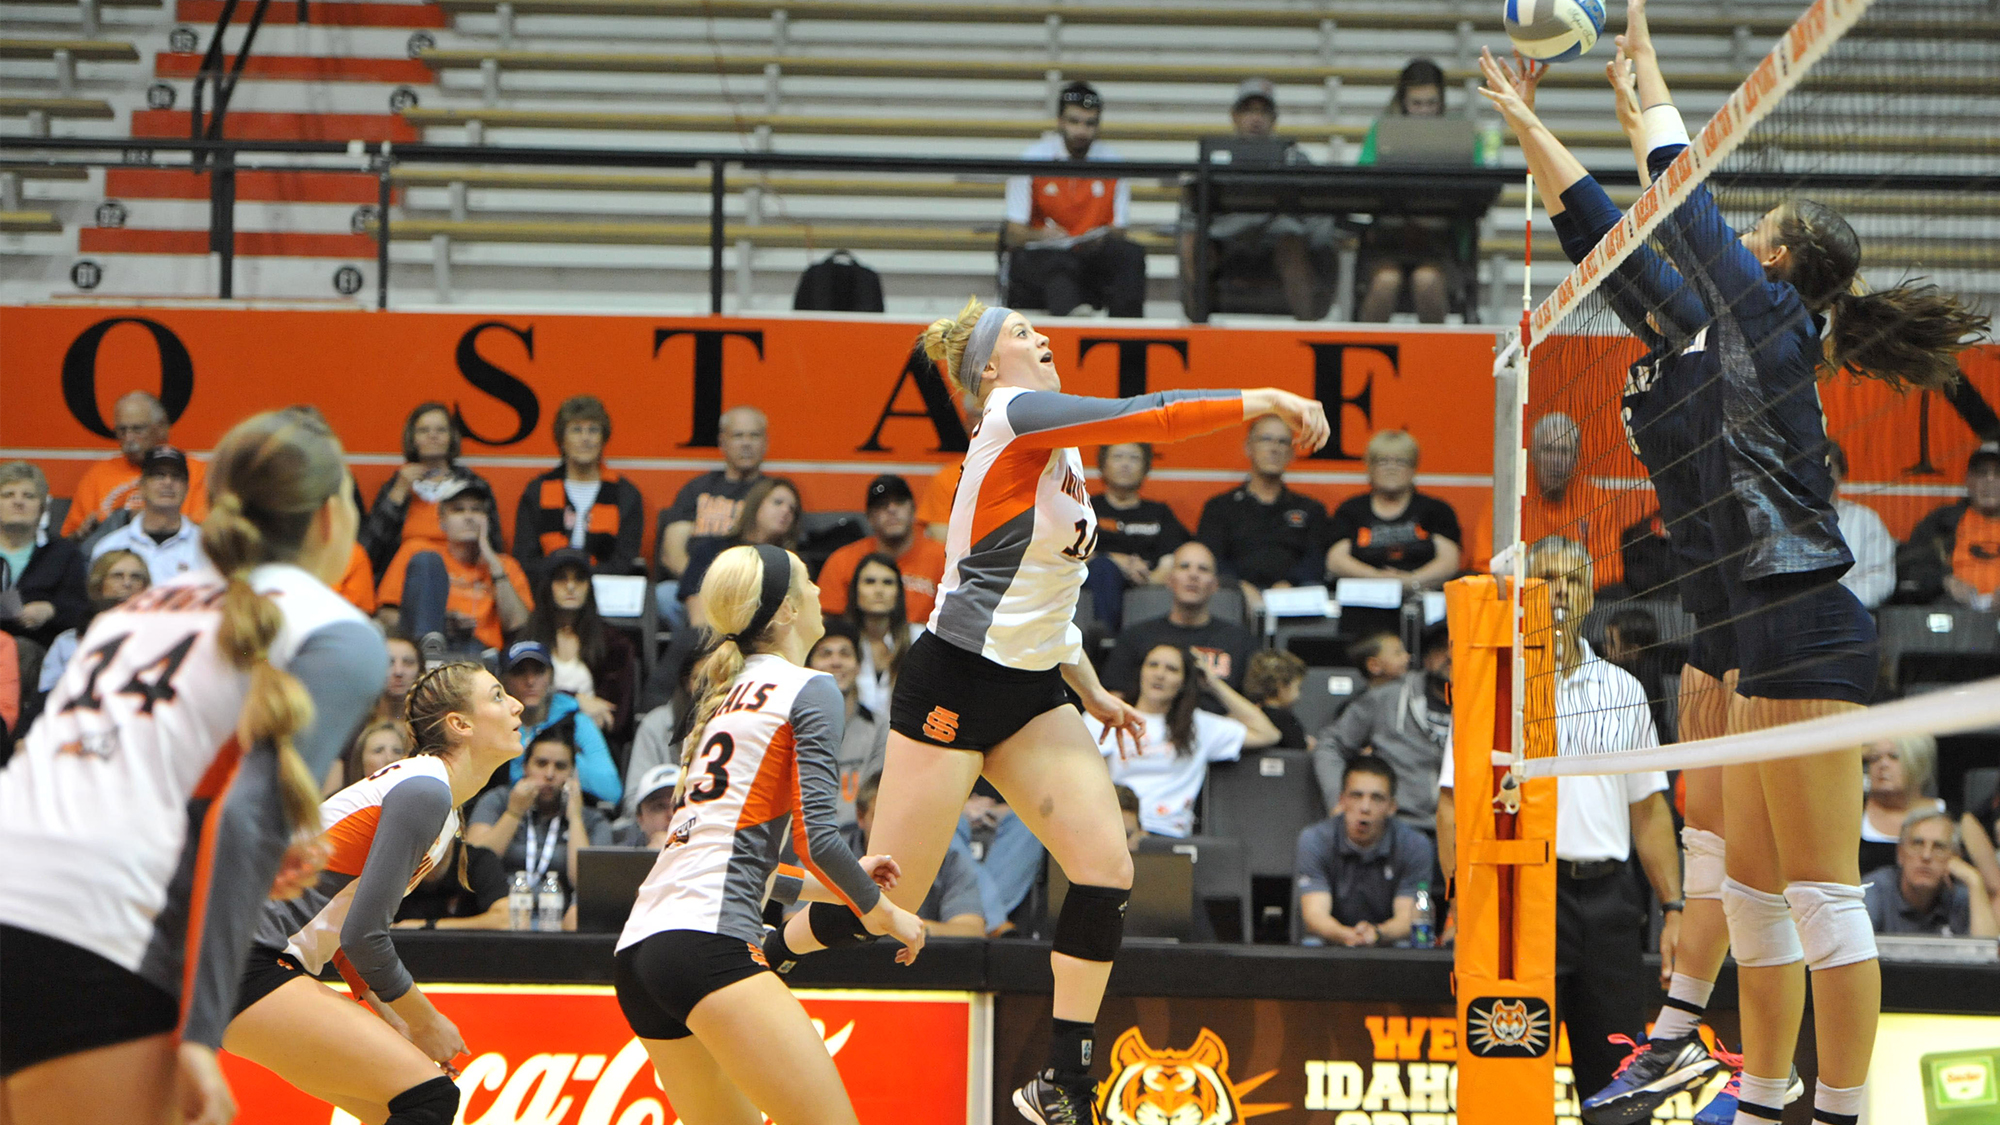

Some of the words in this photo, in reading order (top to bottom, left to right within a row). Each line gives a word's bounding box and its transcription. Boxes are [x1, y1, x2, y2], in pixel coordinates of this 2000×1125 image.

[57, 630, 204, 718] 14
[705, 681, 779, 719] ALS
[672, 730, 736, 813] 3
[1304, 1060, 1458, 1112] IDAH
